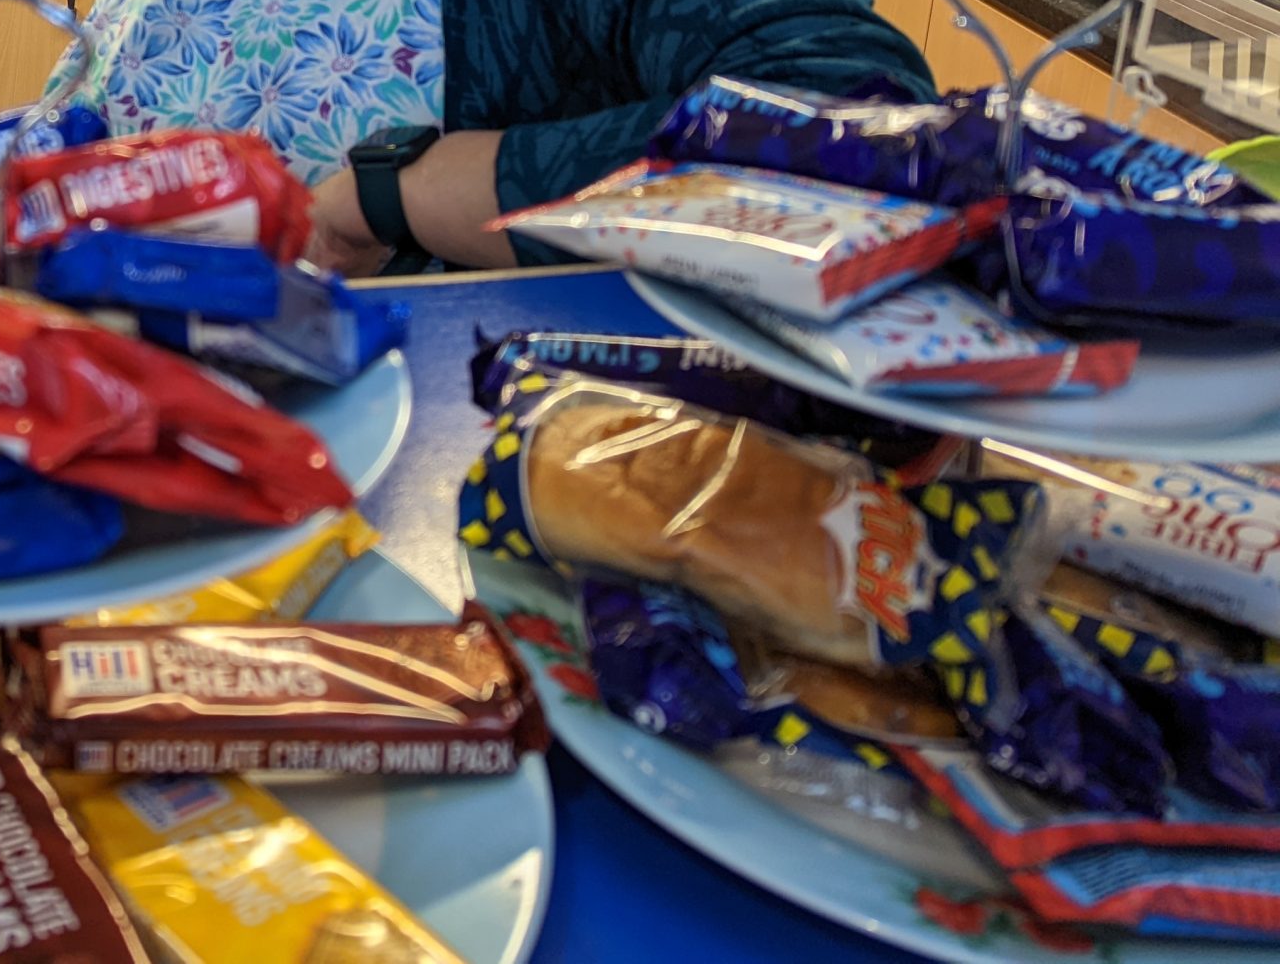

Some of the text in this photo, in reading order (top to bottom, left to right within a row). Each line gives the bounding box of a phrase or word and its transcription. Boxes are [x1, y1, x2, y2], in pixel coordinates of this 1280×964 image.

[69, 650, 140, 679] Hill
[158, 664, 327, 700] CREAMS
[119, 741, 266, 773] CHOCOLATE
[269, 741, 381, 773] CREAMS
[383, 741, 446, 773] MINI
[449, 740, 516, 773] PACK
